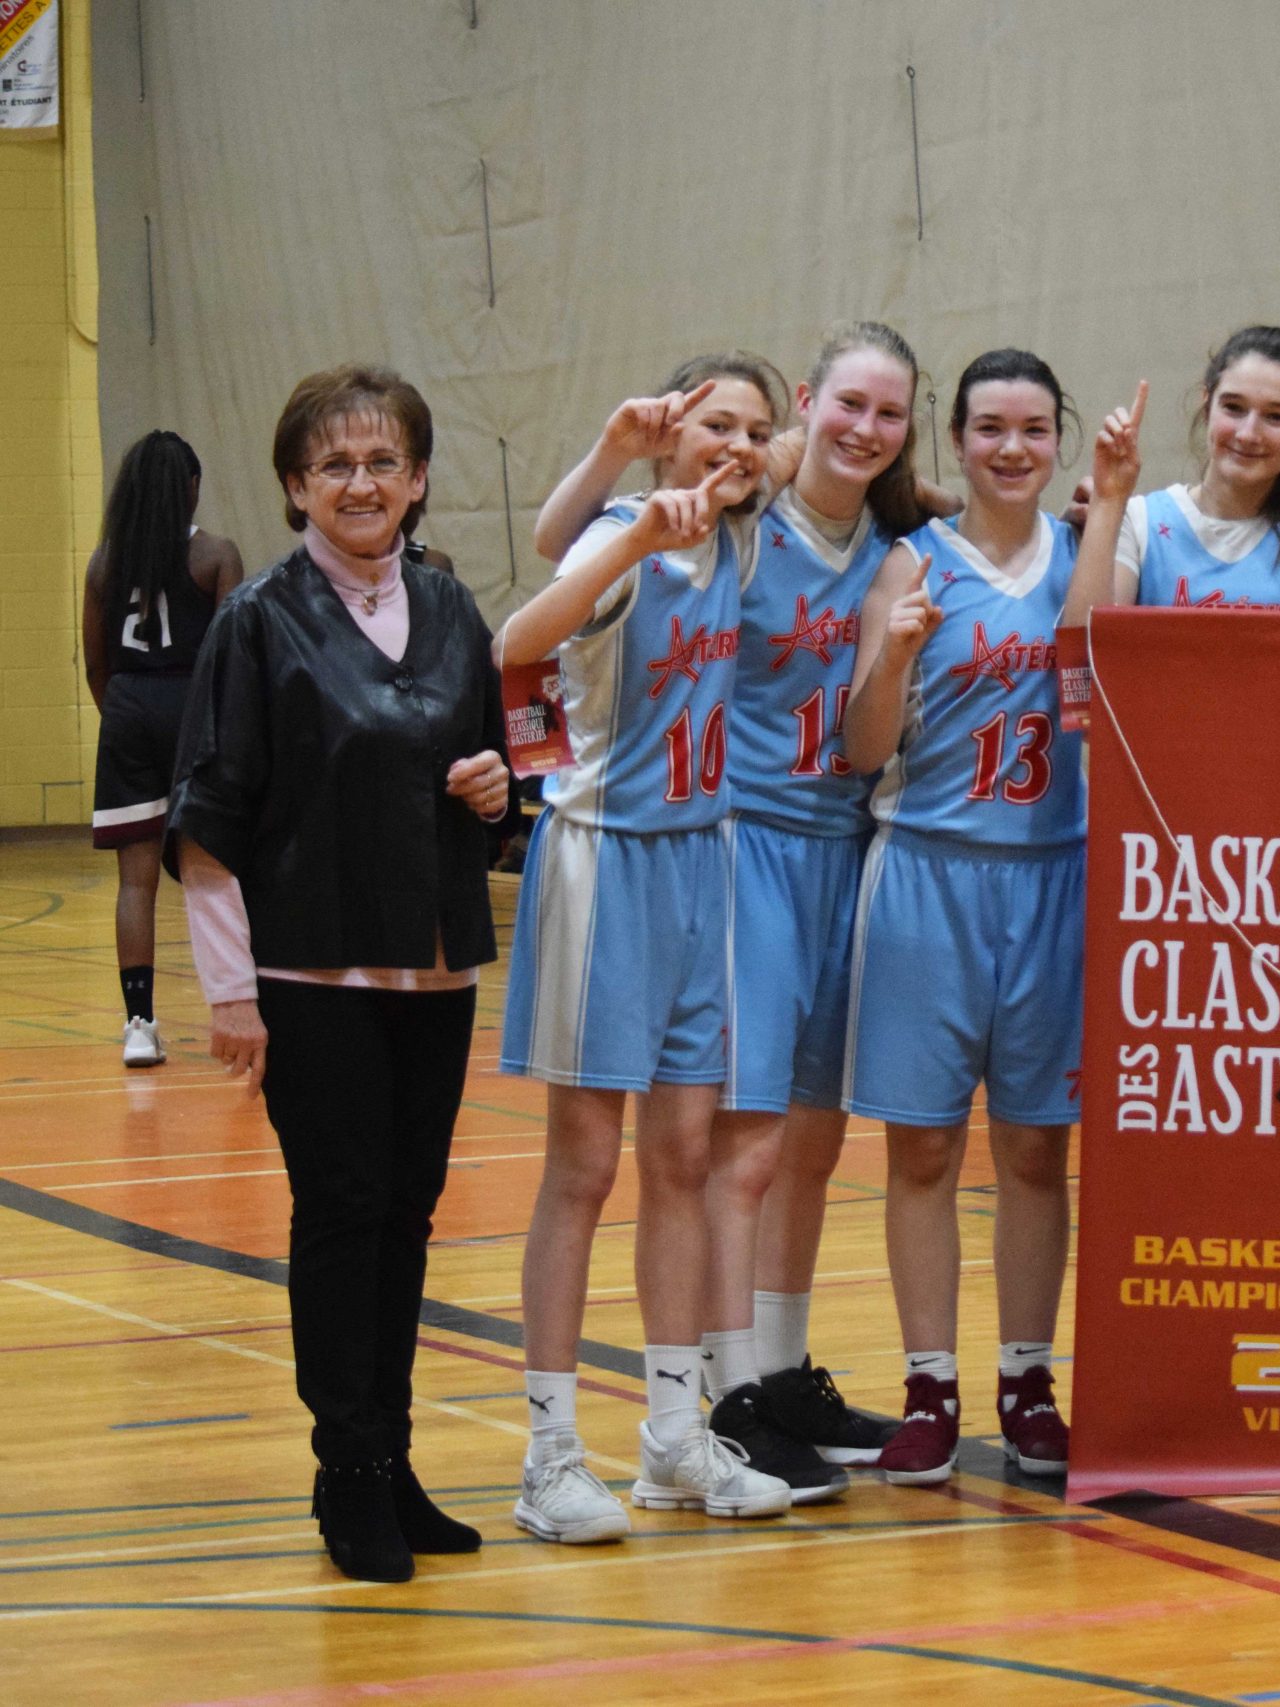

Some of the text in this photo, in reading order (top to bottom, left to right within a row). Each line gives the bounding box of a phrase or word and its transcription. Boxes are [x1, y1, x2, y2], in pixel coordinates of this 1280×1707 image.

[768, 594, 860, 671] ASTÉ
[664, 702, 726, 802] 10
[966, 711, 1053, 805] 13
[1118, 1043, 1159, 1132] DES
